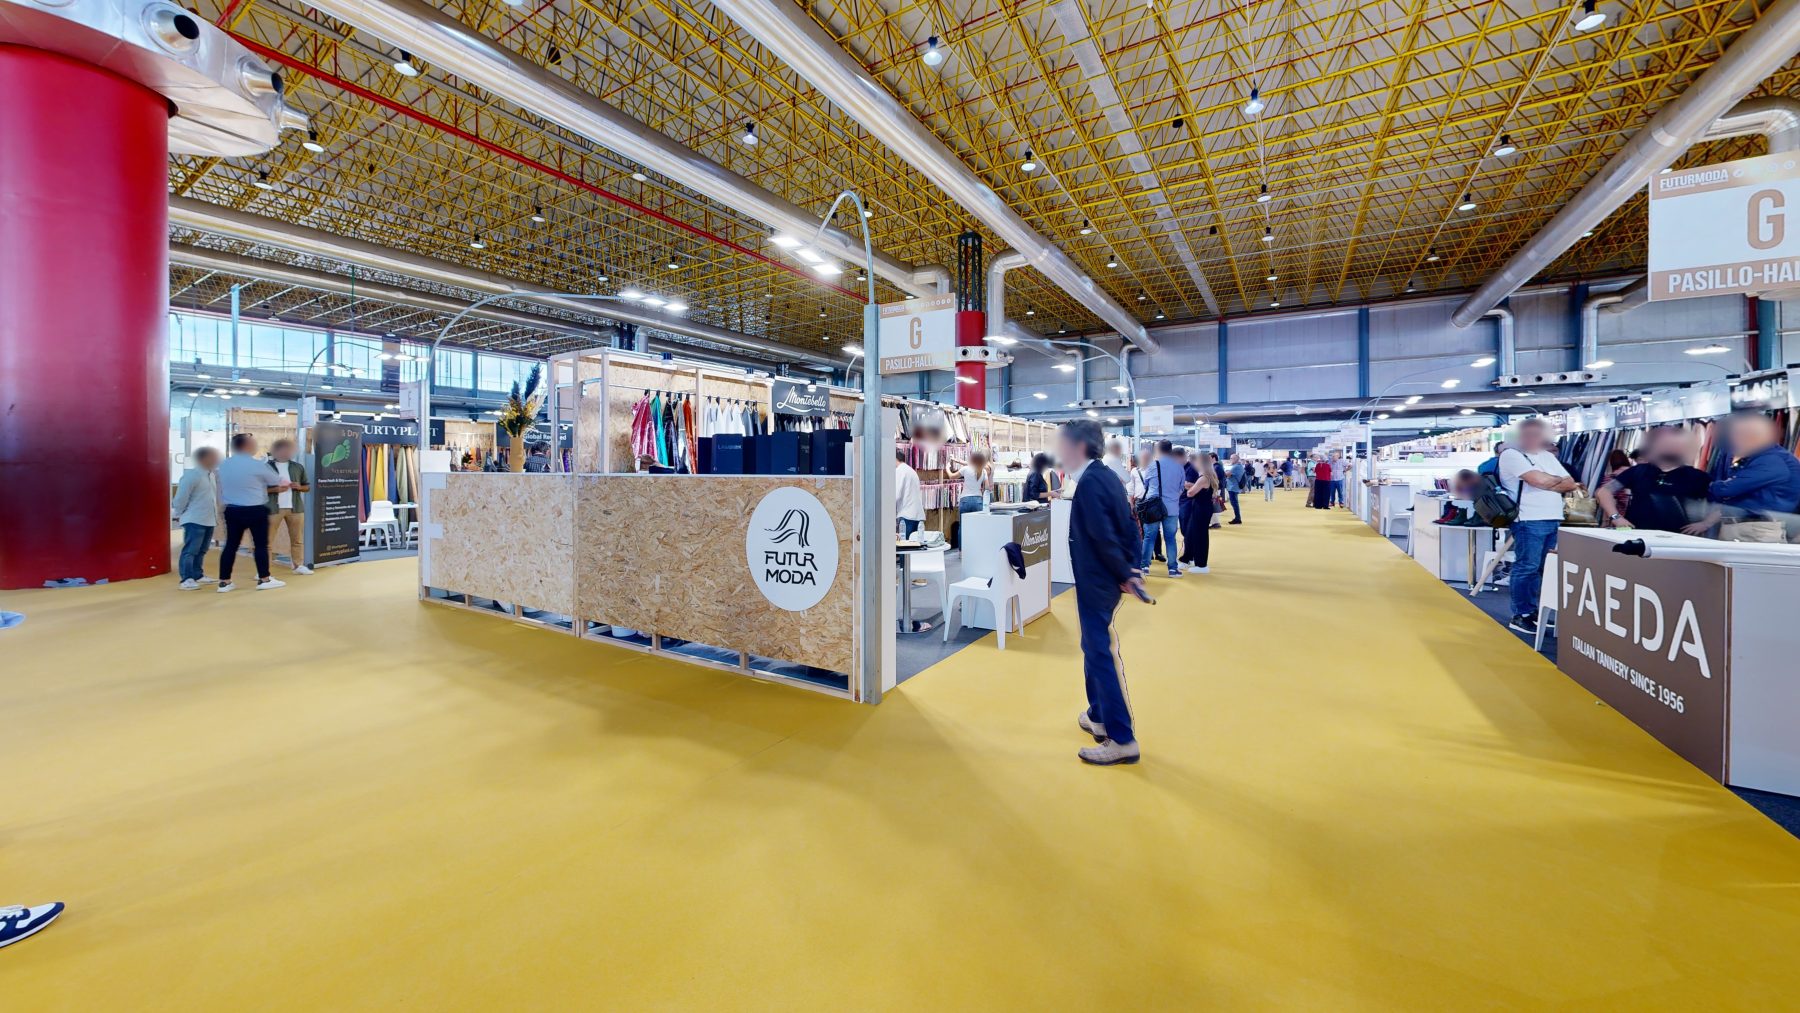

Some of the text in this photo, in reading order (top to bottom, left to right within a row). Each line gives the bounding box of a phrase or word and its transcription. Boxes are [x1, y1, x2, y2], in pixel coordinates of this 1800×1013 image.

[1660, 169, 1729, 189] FUTURMODA
[1748, 189, 1785, 250] G
[910, 317, 922, 349] G
[777, 386, 826, 413] Montebello
[1616, 402, 1645, 416] FAEDA
[347, 430, 359, 440] Dry
[764, 550, 818, 572] FUTUR
[766, 569, 816, 586] MODA
[1563, 561, 1711, 679] FAEDA
[1572, 635, 1685, 714] ITALIAN TANNERY SINCE 1956
